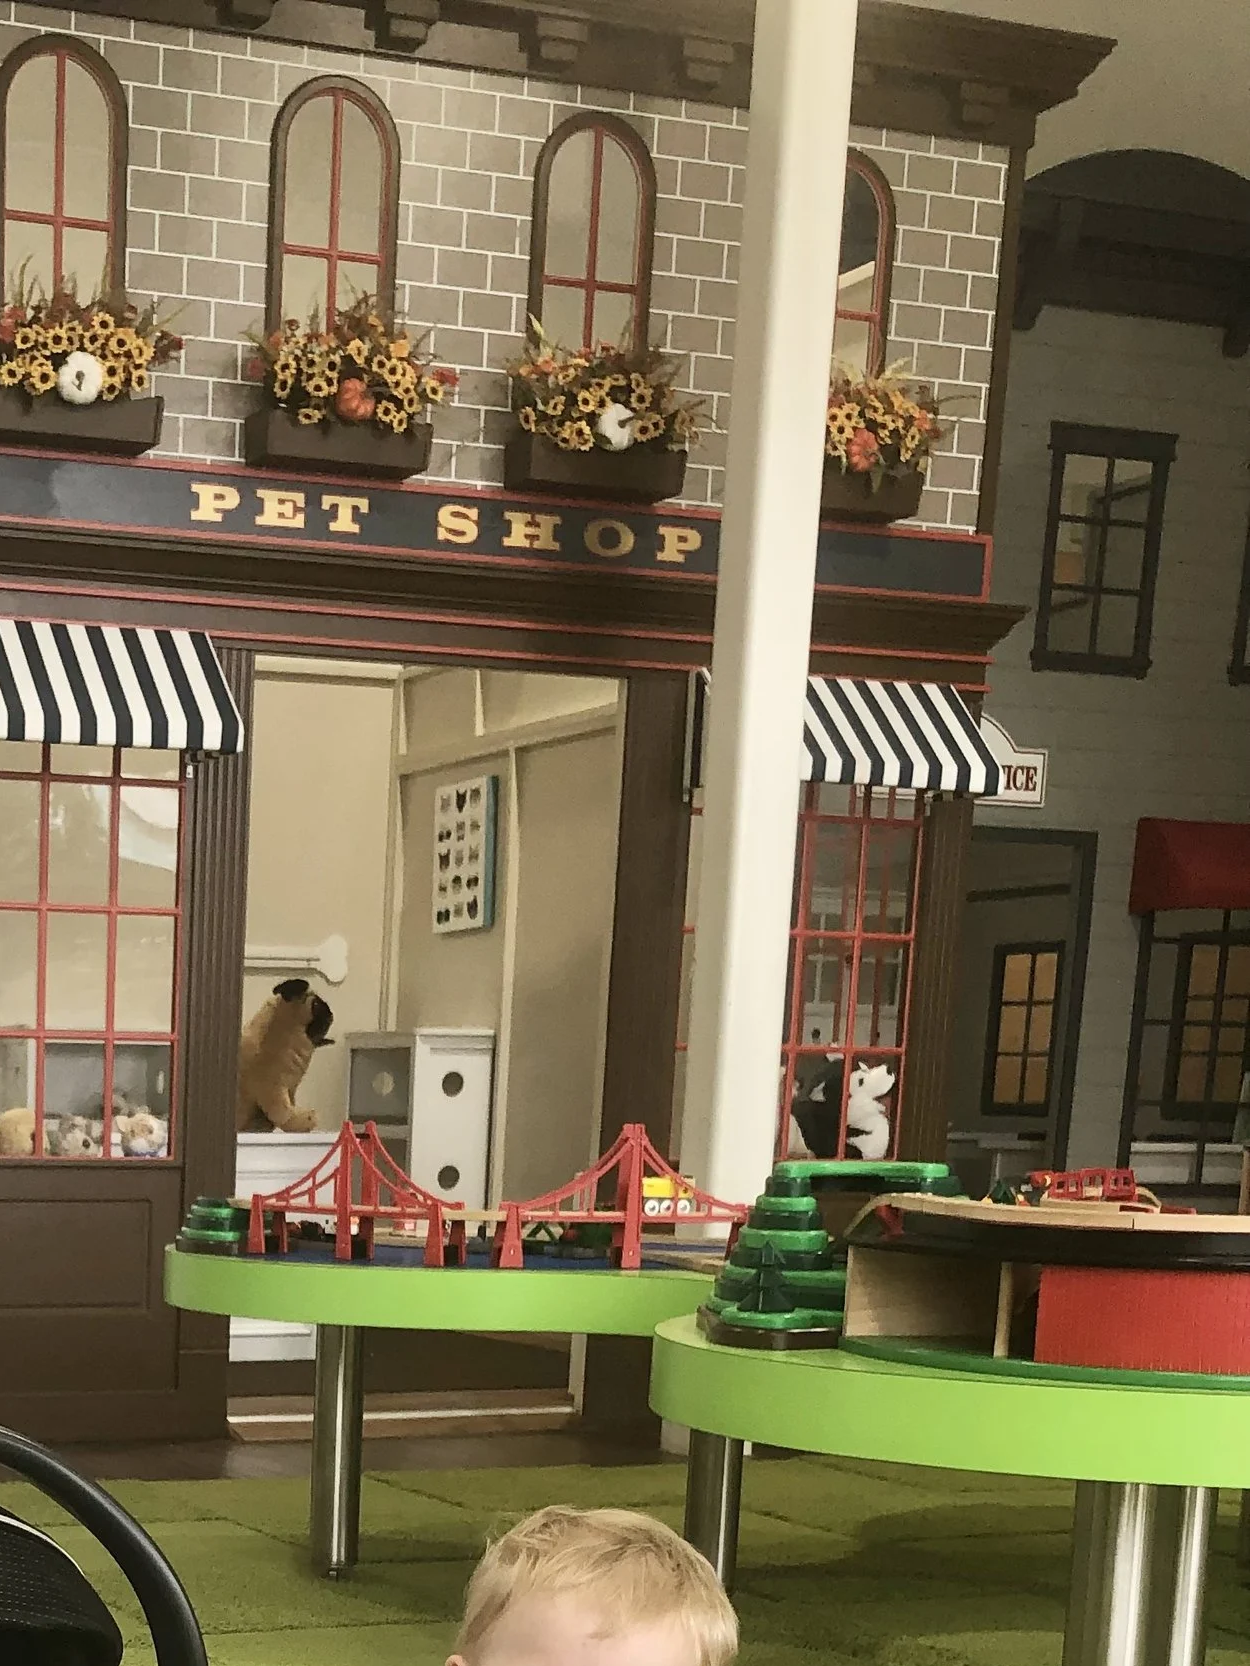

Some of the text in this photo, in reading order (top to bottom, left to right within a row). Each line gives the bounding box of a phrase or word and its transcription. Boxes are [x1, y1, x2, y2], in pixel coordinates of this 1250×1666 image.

[190, 482, 703, 563] PET SHOP
[1002, 765, 1038, 792] ICE
